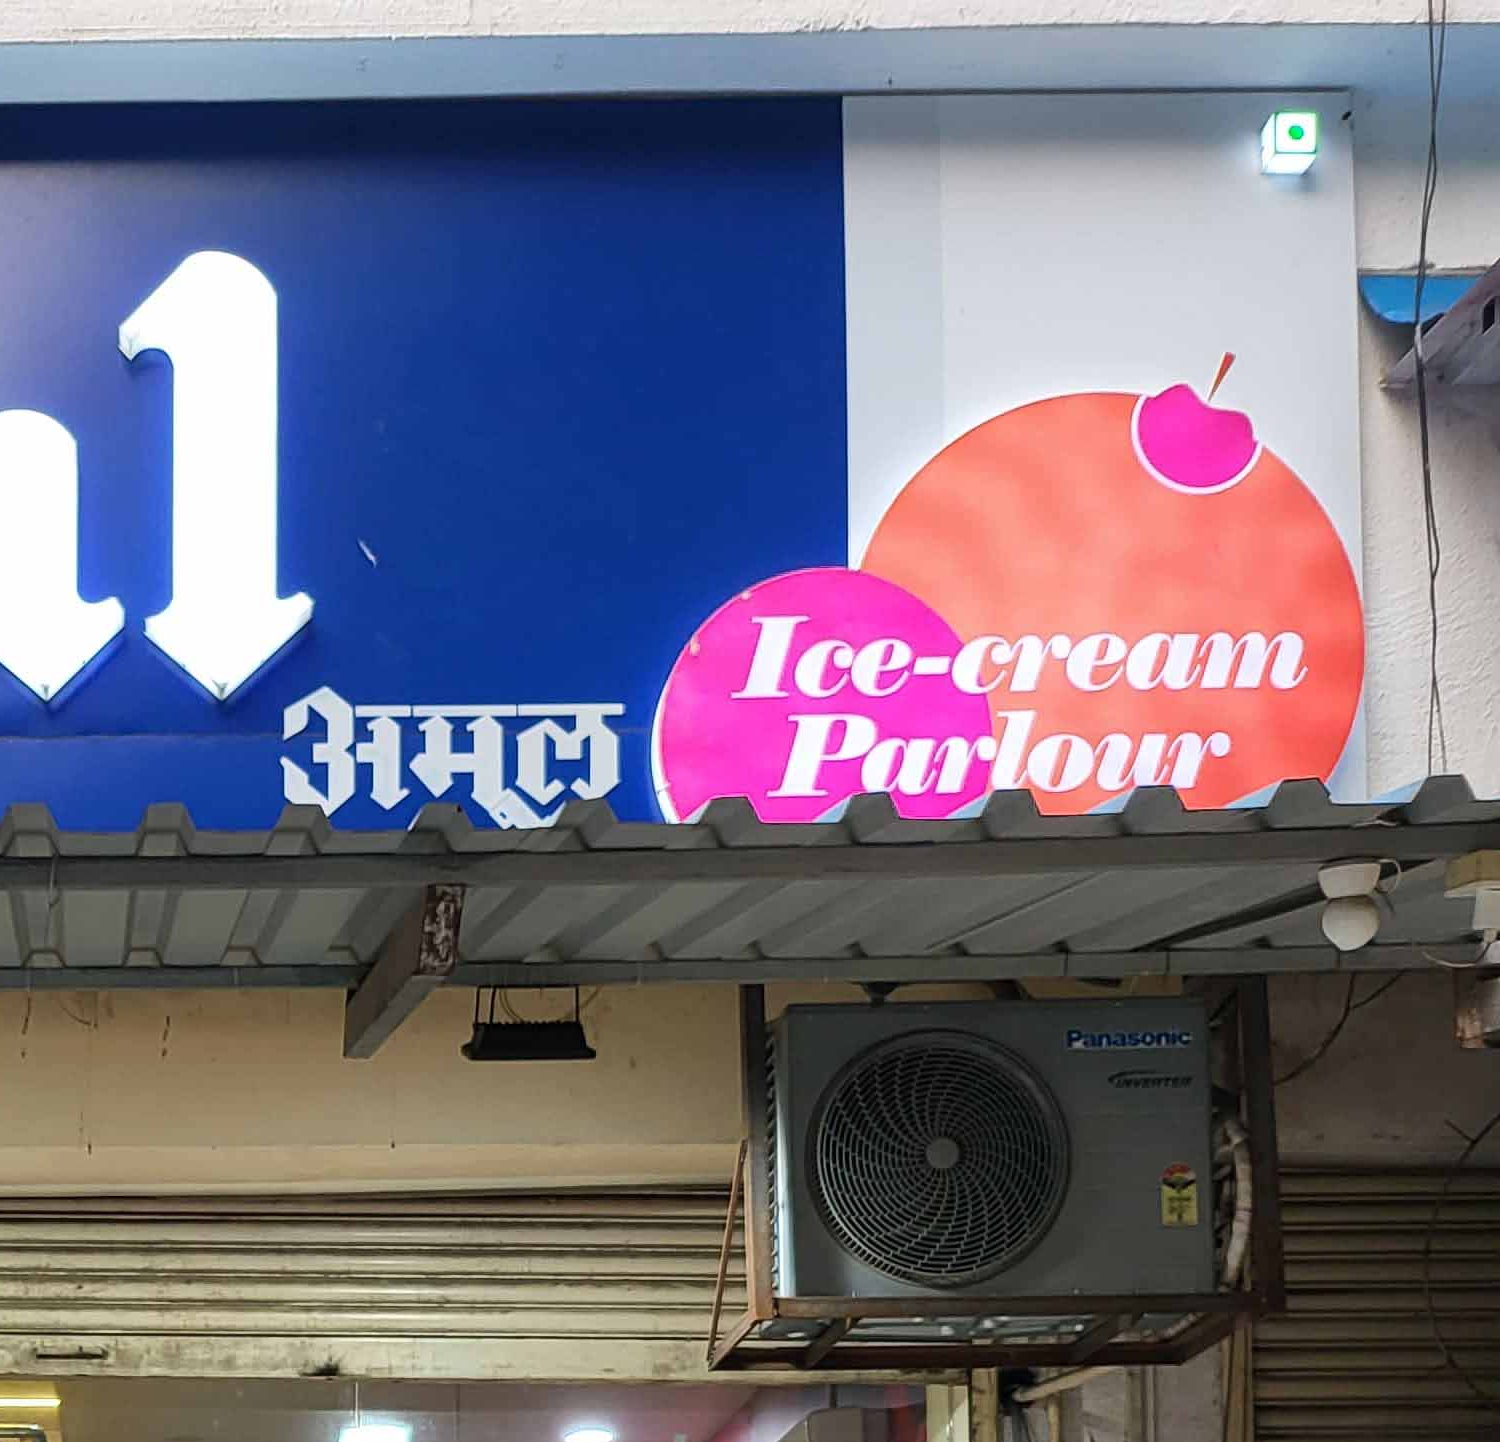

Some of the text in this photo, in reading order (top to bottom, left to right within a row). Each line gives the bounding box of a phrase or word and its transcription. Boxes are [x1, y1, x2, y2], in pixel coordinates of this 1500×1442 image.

[730, 614, 1308, 701] Ice-cream
[766, 709, 1231, 798] Parlour
[1066, 1029, 1193, 1048] Panasonic
